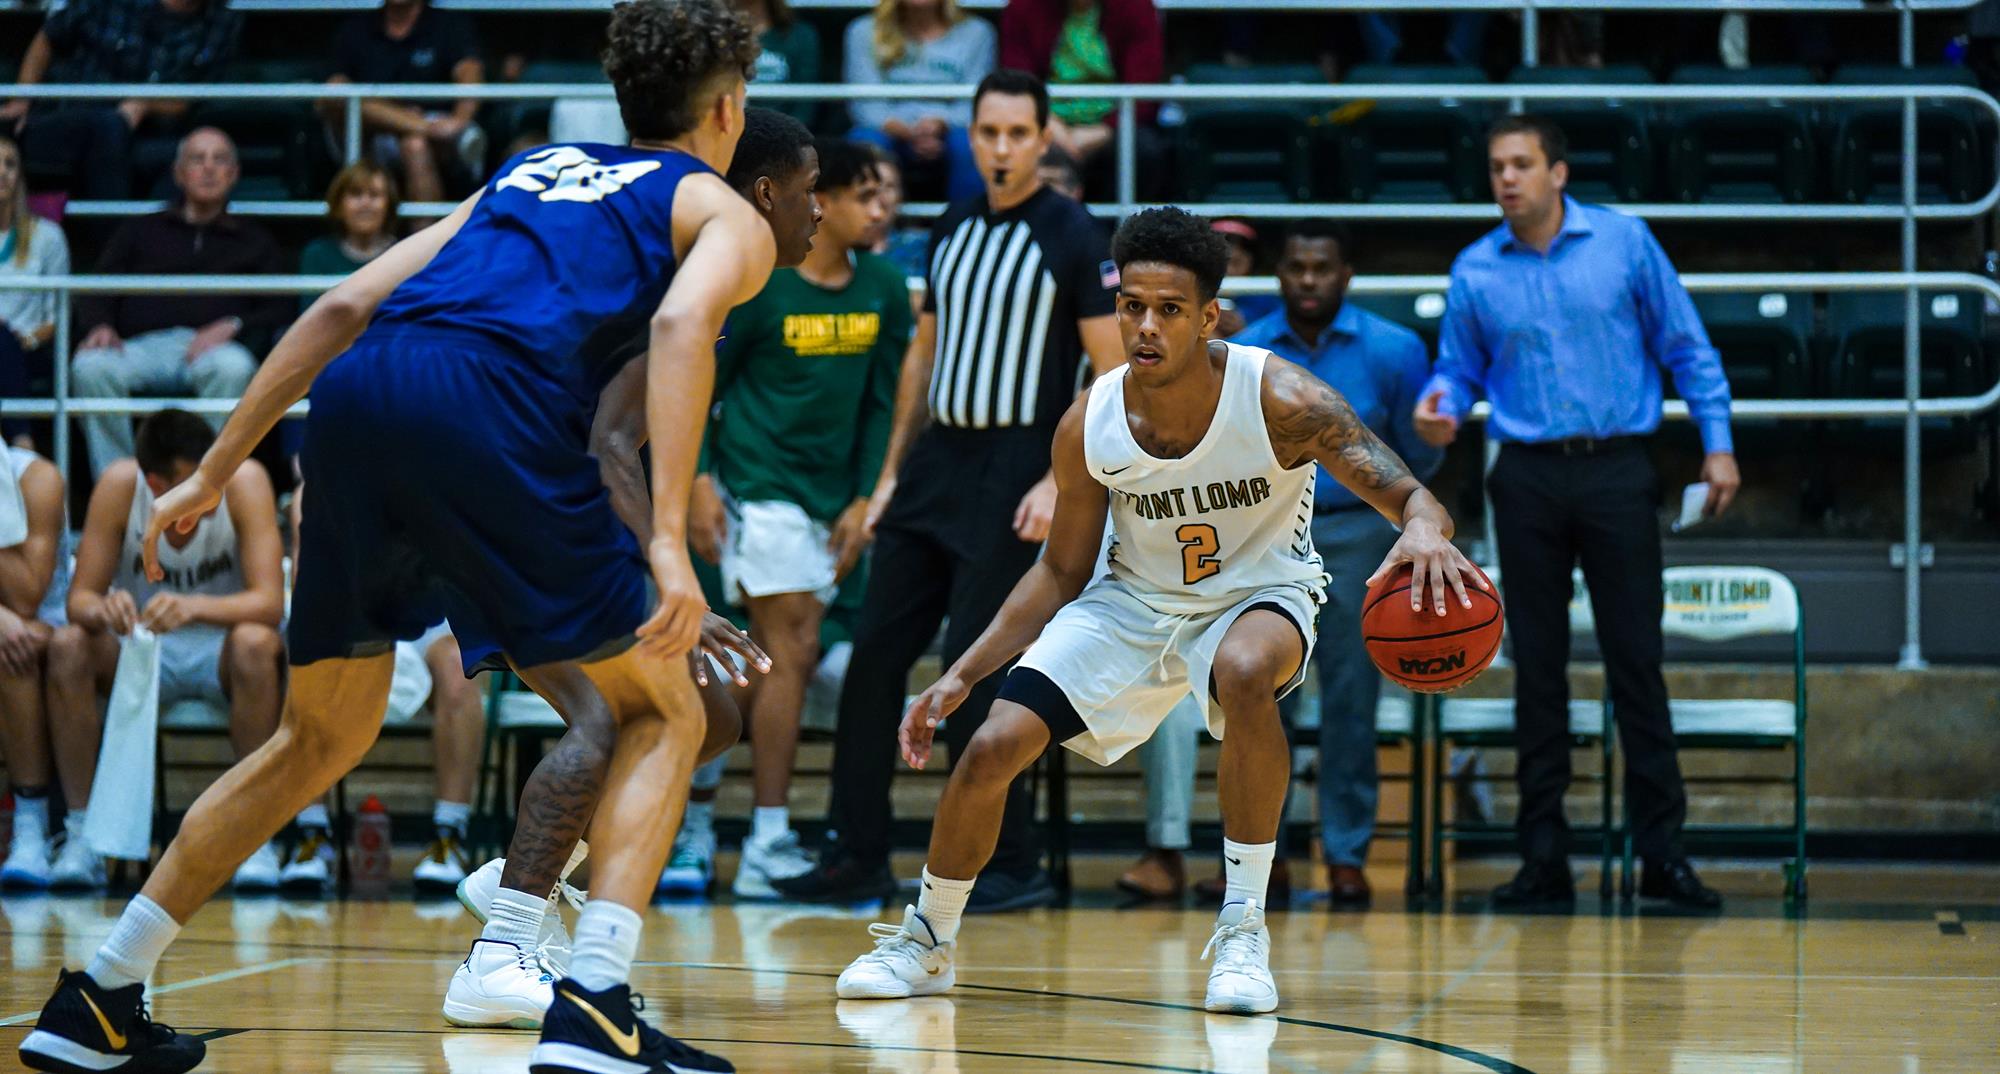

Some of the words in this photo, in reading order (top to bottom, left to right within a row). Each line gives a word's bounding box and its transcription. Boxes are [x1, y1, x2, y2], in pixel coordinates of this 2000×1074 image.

[1191, 476, 1271, 515] LOMA
[1175, 523, 1221, 585] 2
[1717, 579, 1772, 603] LOMA
[1397, 649, 1466, 675] NCAA
